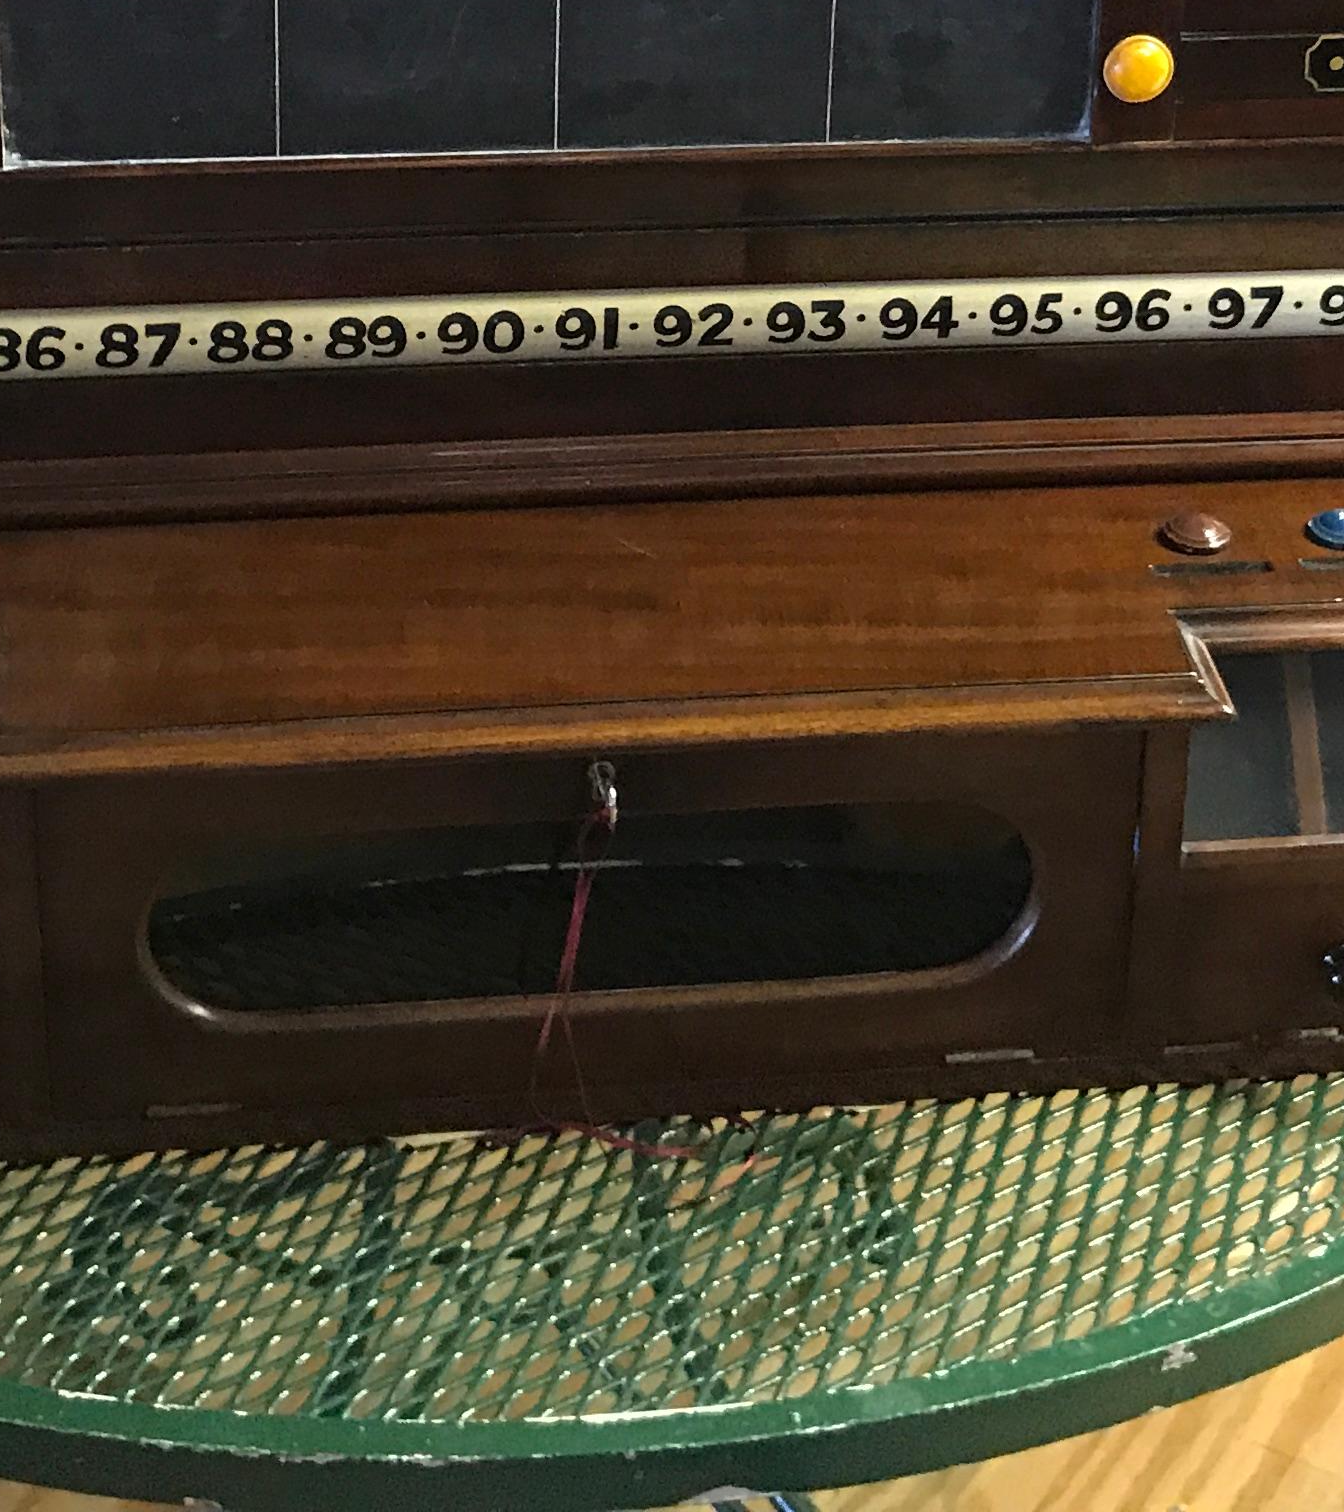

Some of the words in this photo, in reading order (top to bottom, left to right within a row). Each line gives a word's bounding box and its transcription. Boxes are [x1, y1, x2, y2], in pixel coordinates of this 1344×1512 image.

[95, 322, 181, 370] 87
[207, 319, 294, 363] 88
[325, 316, 408, 359] 89
[437, 310, 525, 354] 90
[556, 307, 618, 350] 91
[654, 304, 735, 347] 92
[766, 300, 847, 342] 93
[878, 296, 958, 340] 94
[988, 293, 1062, 336] 95
[1094, 289, 1172, 334] 96
[1207, 287, 1285, 330] 97
